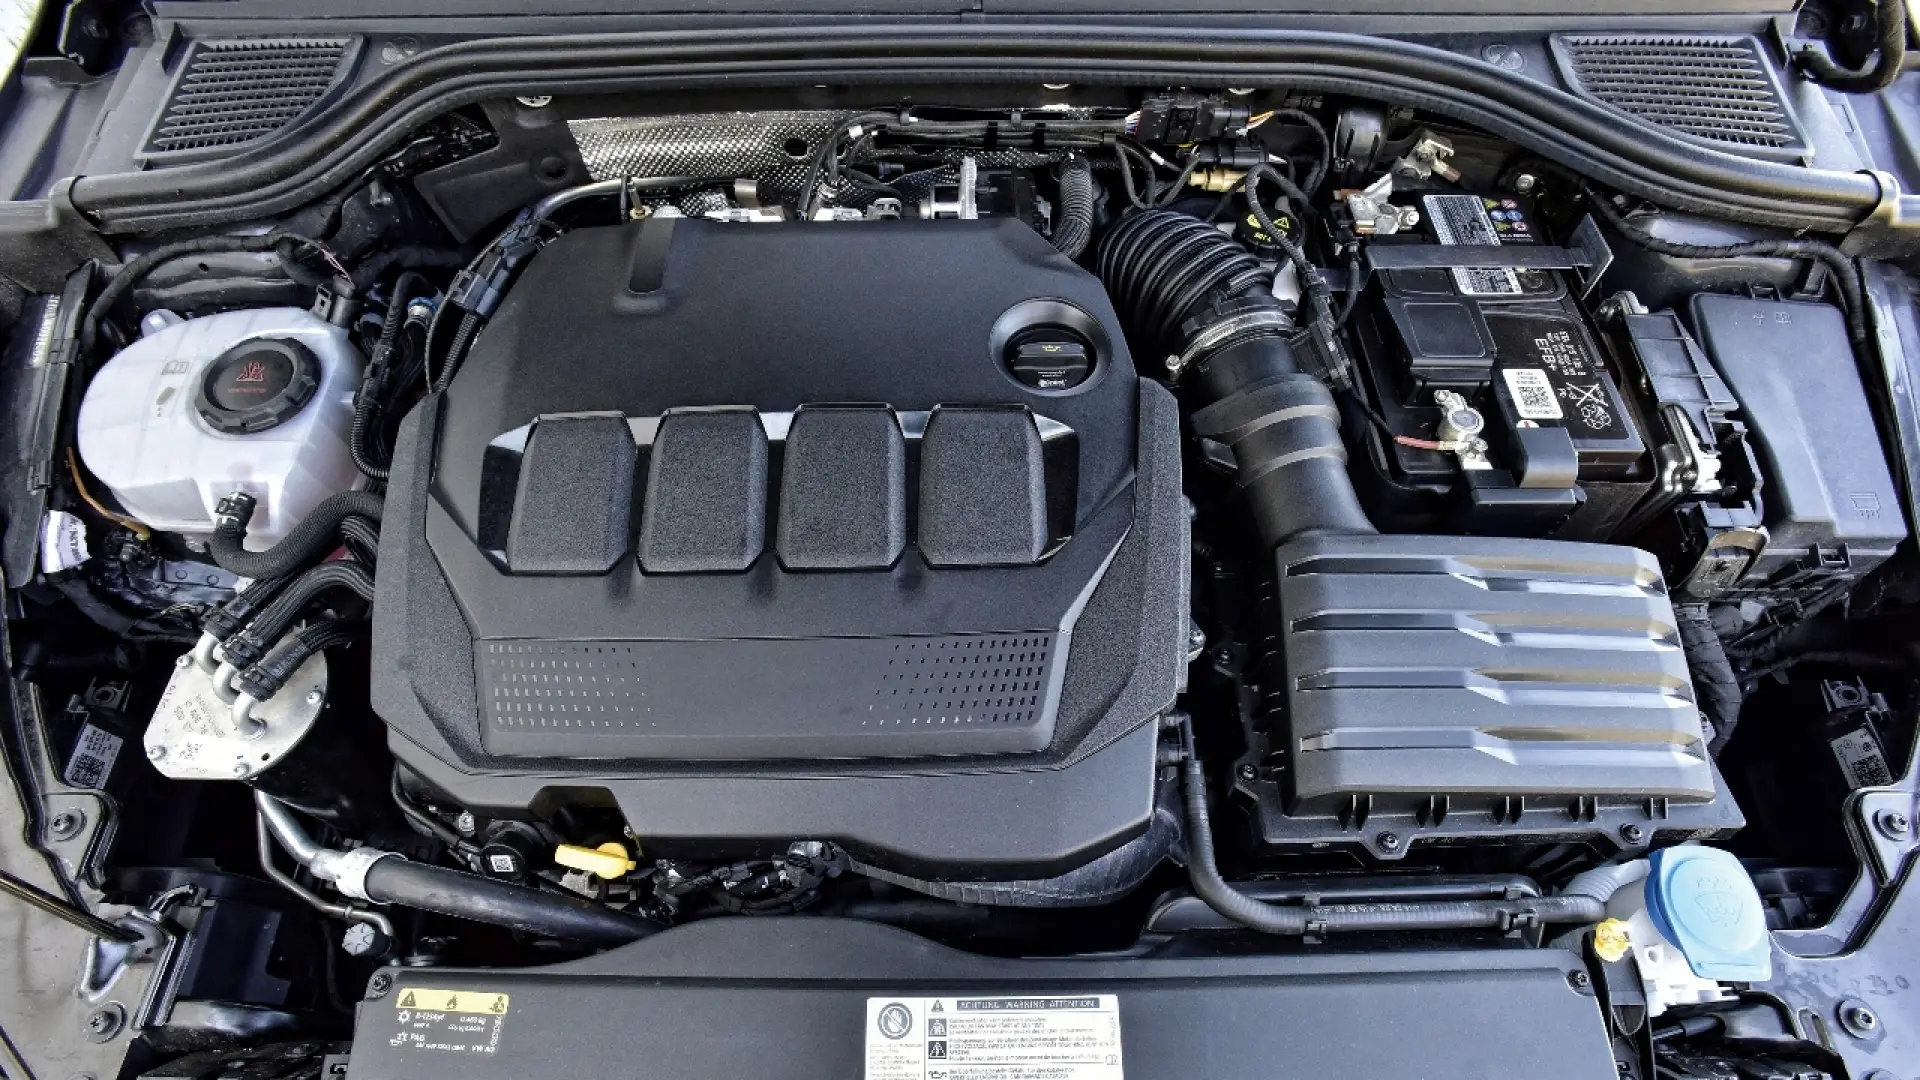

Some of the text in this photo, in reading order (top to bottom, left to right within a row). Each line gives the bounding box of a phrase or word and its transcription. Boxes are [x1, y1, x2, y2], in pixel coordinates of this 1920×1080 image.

[1534, 338, 1557, 371] EFB+
[960, 999, 1095, 1009] ACHTUNG WARNING ATTENTION
